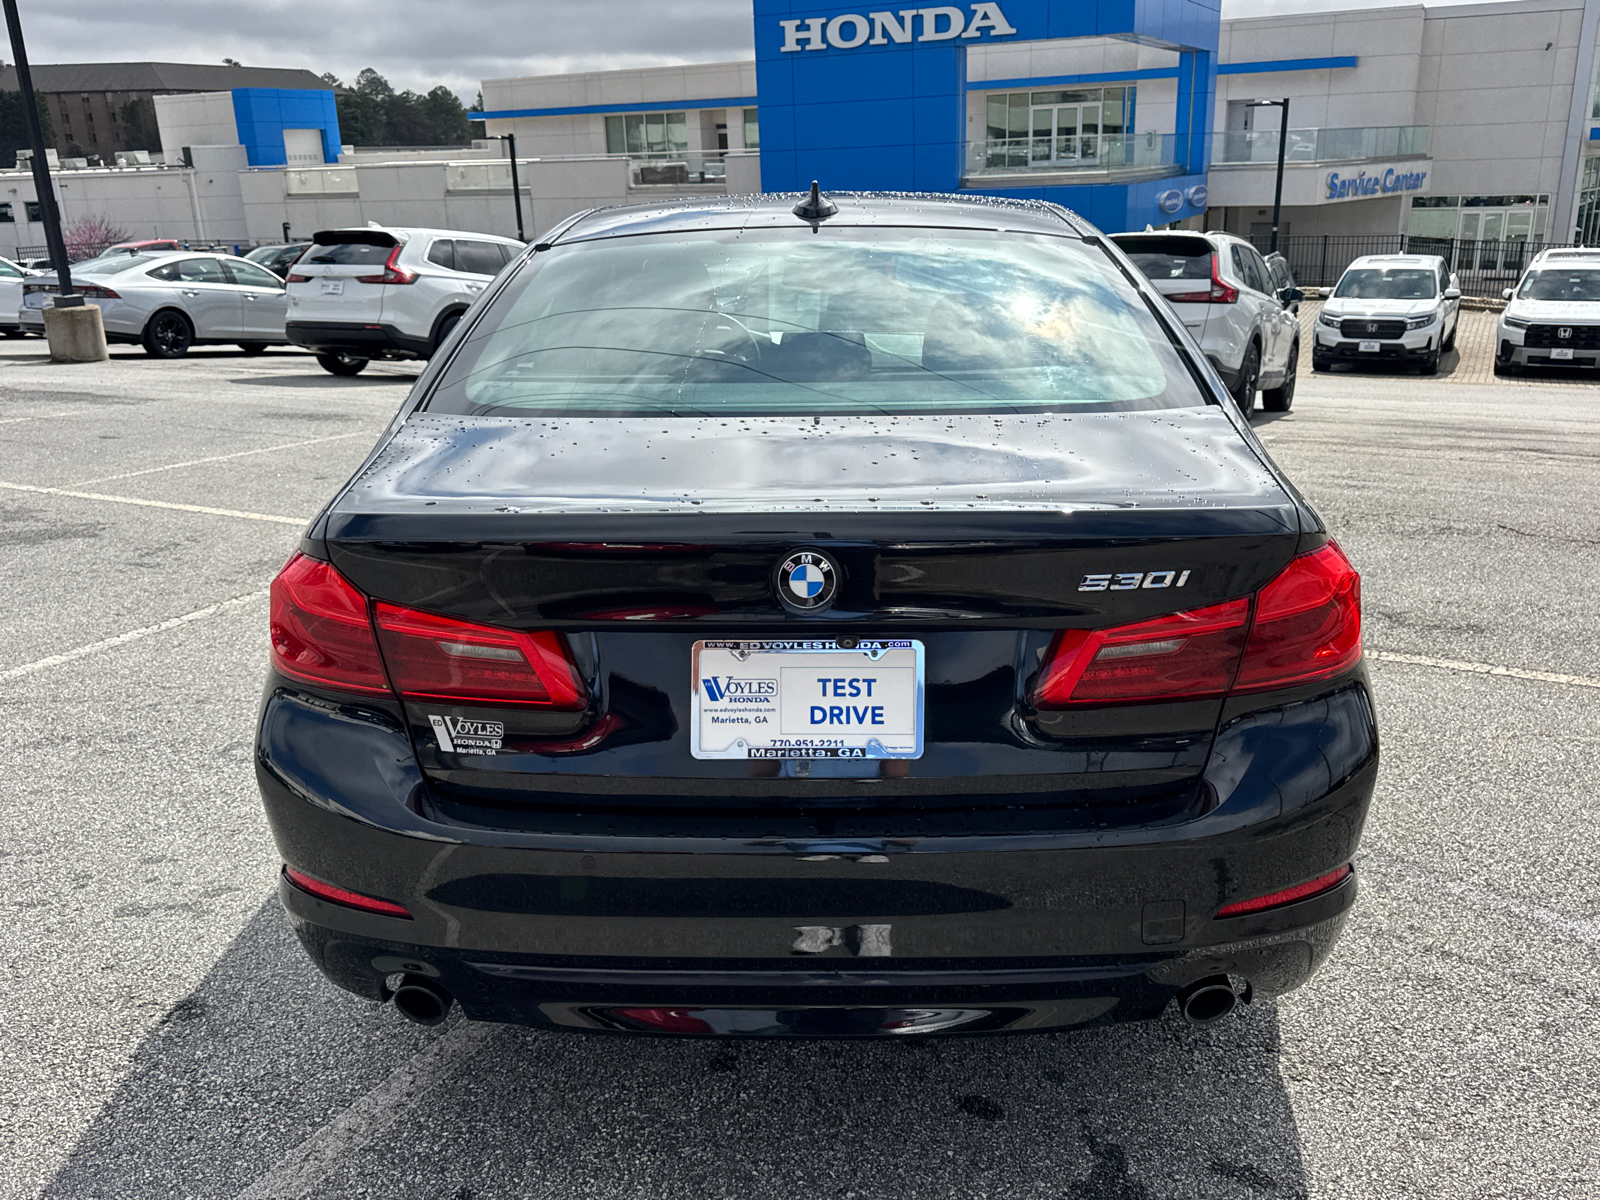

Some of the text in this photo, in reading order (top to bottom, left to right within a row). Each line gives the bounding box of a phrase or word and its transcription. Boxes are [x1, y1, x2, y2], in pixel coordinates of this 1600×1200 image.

[780, 2, 1016, 52] HONDA
[1326, 167, 1427, 199] Service Center
[783, 554, 830, 573] BMW
[1078, 570, 1191, 592] 530i
[817, 677, 877, 697] TEST
[711, 715, 769, 725] Marietta, GA
[810, 705, 885, 725] DRIVE
[432, 715, 503, 738] ED VOYLES
[453, 738, 492, 747] HONDA
[456, 747, 497, 756] Marietta, GA
[750, 748, 863, 758] Marietta, GA
